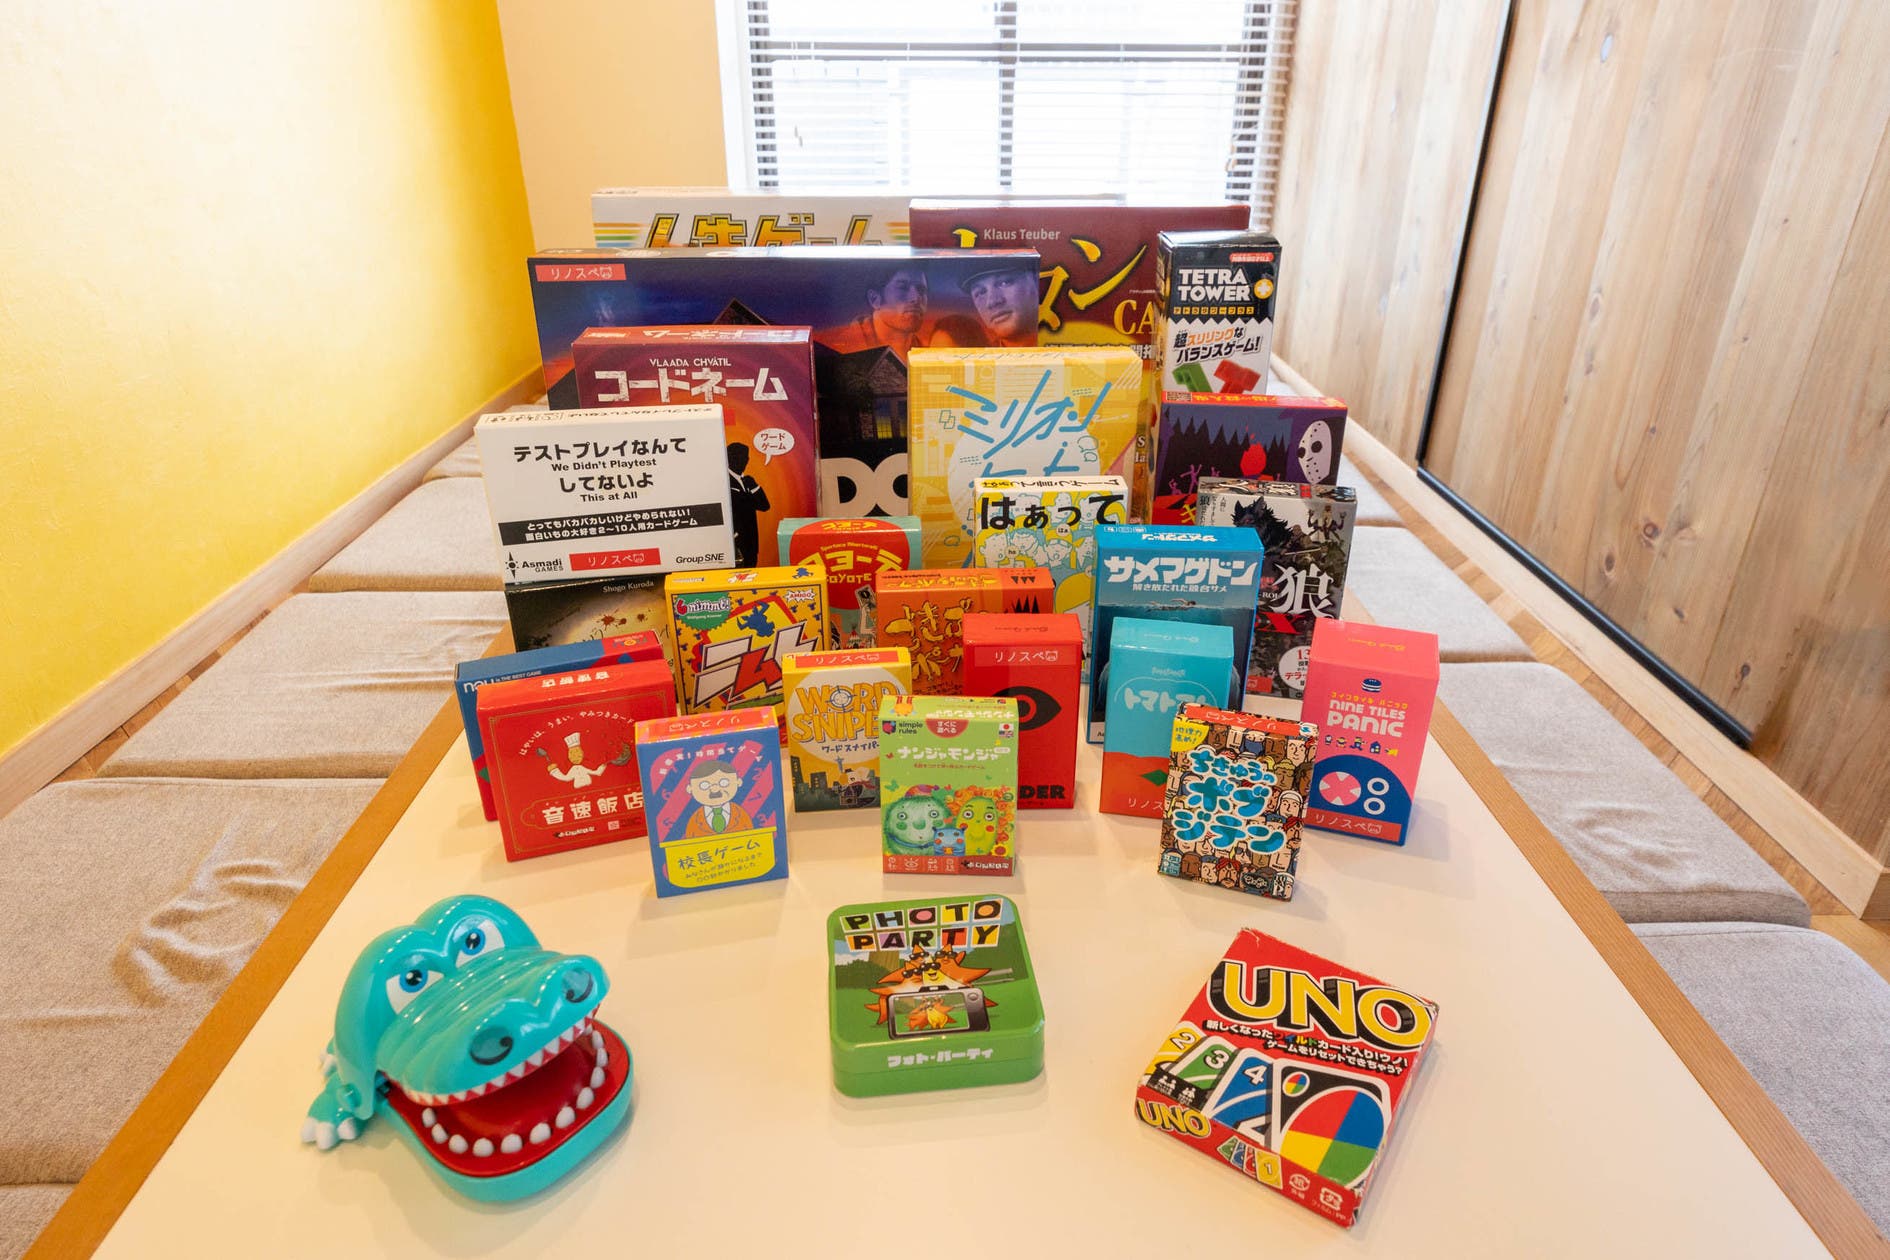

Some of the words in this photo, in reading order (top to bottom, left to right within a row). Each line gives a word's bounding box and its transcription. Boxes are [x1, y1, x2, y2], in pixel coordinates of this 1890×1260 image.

[983, 228, 1017, 240] Klaus
[1019, 228, 1061, 241] Teuber
[551, 267, 600, 280] リノスペ
[1178, 268, 1247, 285] TETRA
[1178, 285, 1251, 301] TOWER
[1173, 327, 1244, 349] 超スリリングな
[649, 358, 689, 367] VLAADA
[595, 367, 789, 403] コードネーム
[760, 431, 786, 442] ワード
[514, 437, 687, 462] テストプレイなんて
[761, 441, 786, 452] ゲーム
[551, 463, 570, 472] We
[573, 460, 607, 470] Didn't
[610, 458, 657, 469] Playtest
[560, 472, 654, 493] してないよ
[580, 493, 605, 502] This
[608, 493, 620, 501] at
[623, 492, 638, 500] All
[981, 494, 1124, 530] はぁって
[522, 558, 563, 569] Asmadi
[587, 554, 634, 567] リノスペ
[675, 555, 704, 565] Group
[704, 552, 725, 562] SNE
[535, 565, 564, 573] GAMES
[603, 584, 626, 593] Shogo
[628, 580, 655, 590] Kuroda
[826, 573, 873, 584] OYOTE
[815, 654, 867, 665] リノスペ
[995, 650, 1044, 663] リノスペ
[795, 680, 901, 714] WORD
[1368, 705, 1406, 721] TILES
[791, 711, 880, 743] SNIPE
[898, 721, 923, 729] simple
[1327, 710, 1405, 738] PANIC
[897, 746, 1000, 761] ナンジャモンジャ
[1189, 749, 1276, 785] ちきゅうの
[1128, 797, 1164, 810] リノス
[1187, 777, 1272, 818] ボブ
[542, 791, 644, 825] 音速飯店
[1173, 810, 1286, 853] ジテン
[1315, 813, 1368, 832] リノスペ
[677, 839, 761, 870] 校長ゲーム
[844, 899, 1002, 930] PHOTO
[852, 925, 1000, 951] PARTY
[1207, 960, 1432, 1053] UNO
[1170, 1031, 1196, 1050] 2
[1204, 1049, 1230, 1070] 3
[1242, 1064, 1268, 1086] 4
[1135, 1096, 1211, 1138] UNO
